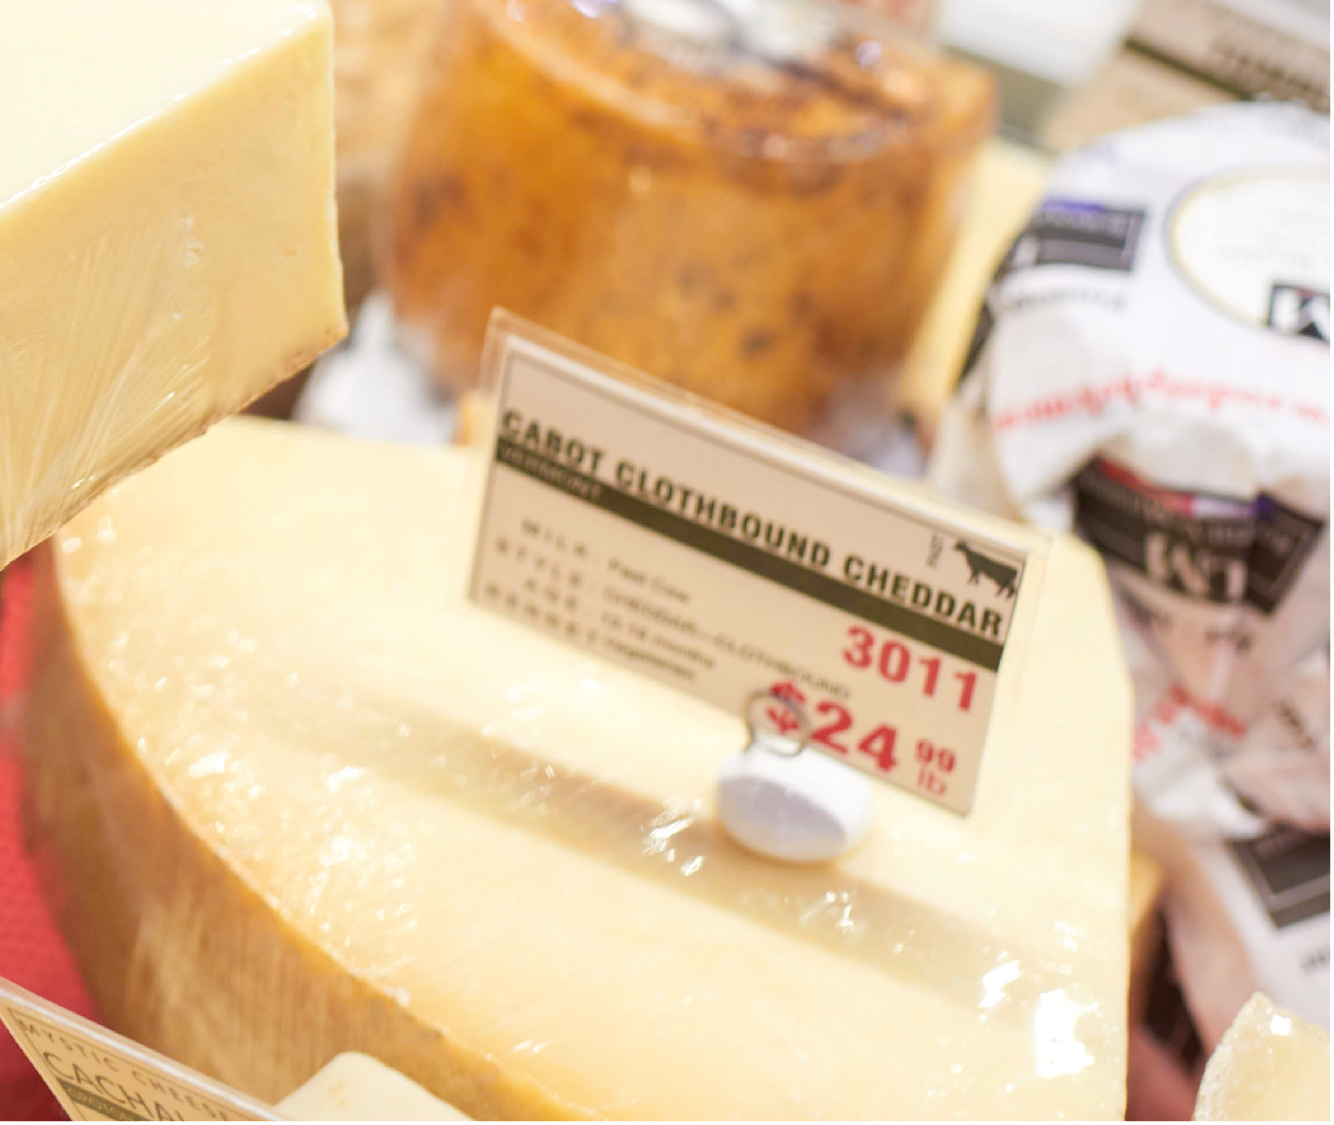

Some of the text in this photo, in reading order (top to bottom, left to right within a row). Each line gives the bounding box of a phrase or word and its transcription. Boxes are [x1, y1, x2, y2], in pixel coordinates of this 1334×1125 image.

[501, 409, 1003, 636] CABOT CLOTHBOUND CHEDDAR
[842, 624, 978, 712] 3011
[765, 680, 898, 772] $24
[18, 1018, 120, 1073] MYSTIC
